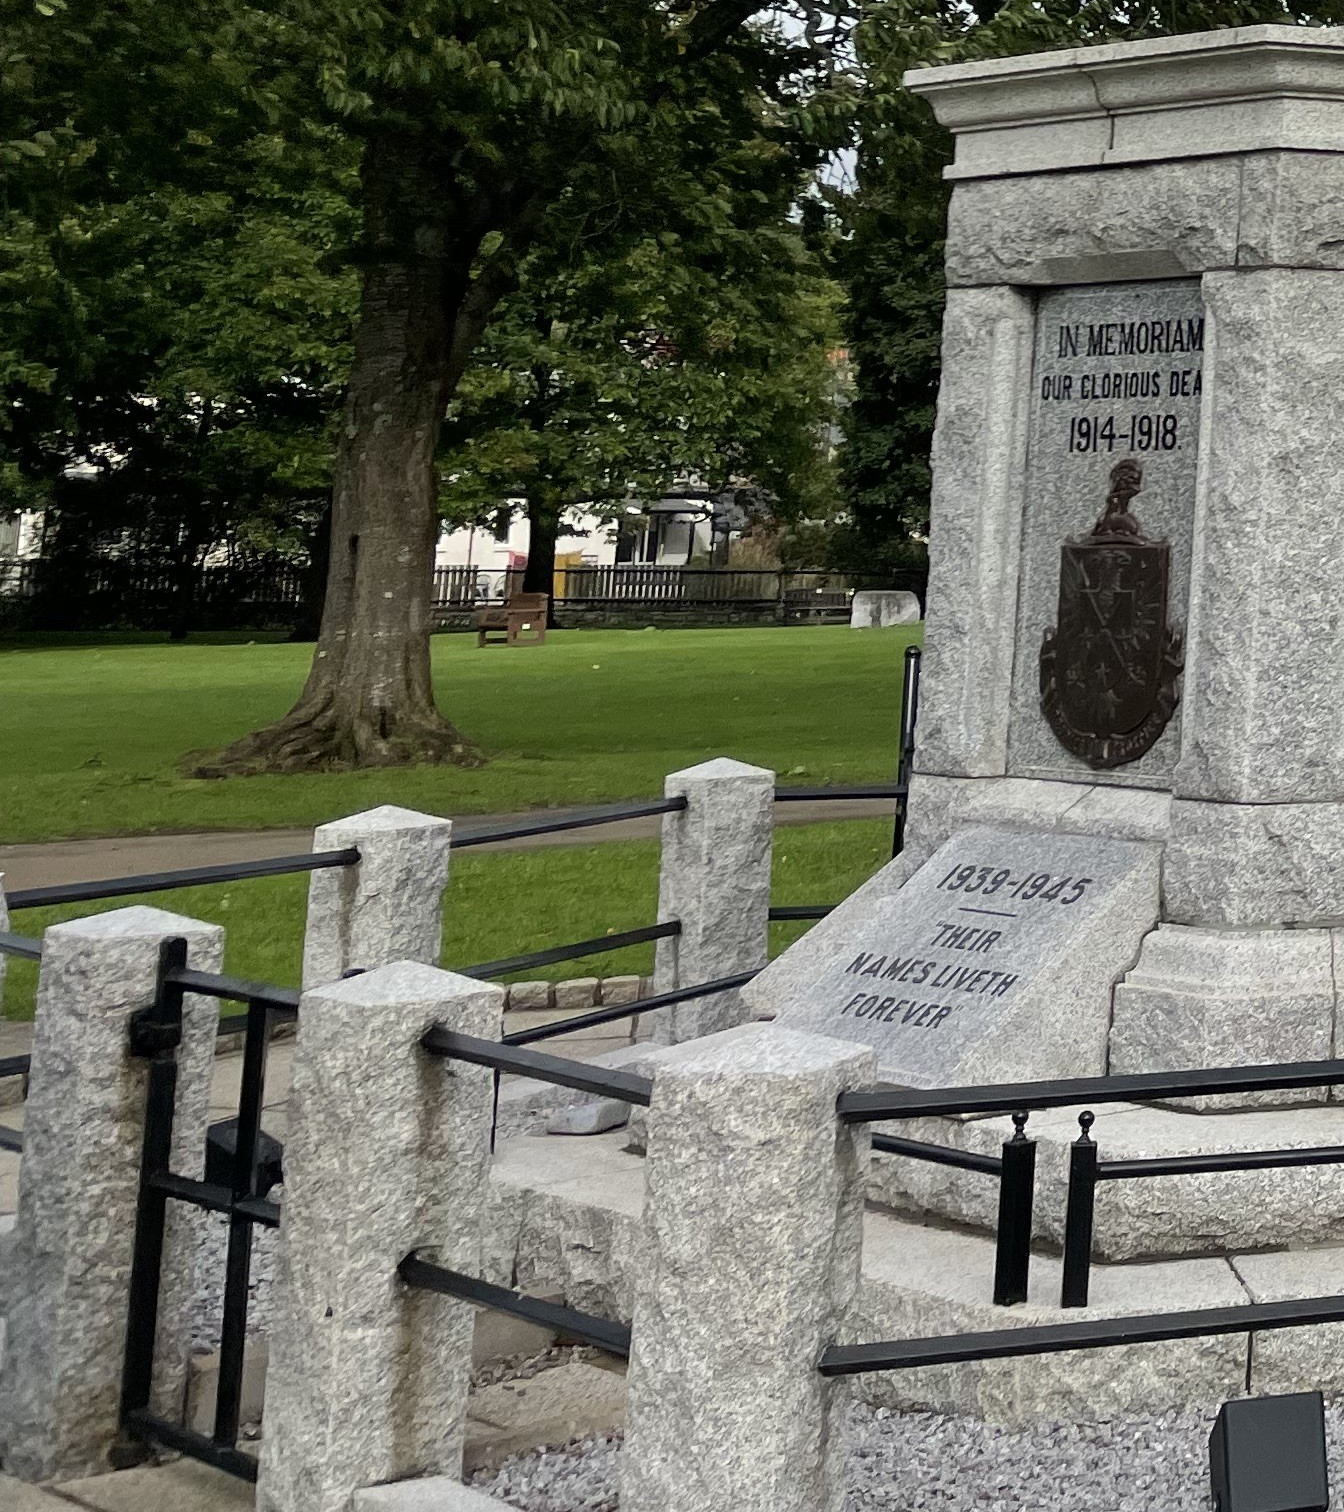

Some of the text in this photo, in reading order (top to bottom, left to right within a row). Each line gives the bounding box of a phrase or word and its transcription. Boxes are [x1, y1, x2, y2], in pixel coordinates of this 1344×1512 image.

[1058, 318, 1204, 358] IN MEMORIAM
[1041, 370, 1202, 400] OUR GLORIOUS DEA
[937, 863, 1094, 904] 1939-1945
[930, 920, 1002, 953] "THEIR
[845, 952, 1018, 997] NAMES LIVETH
[841, 993, 965, 1029] FOREVER"
